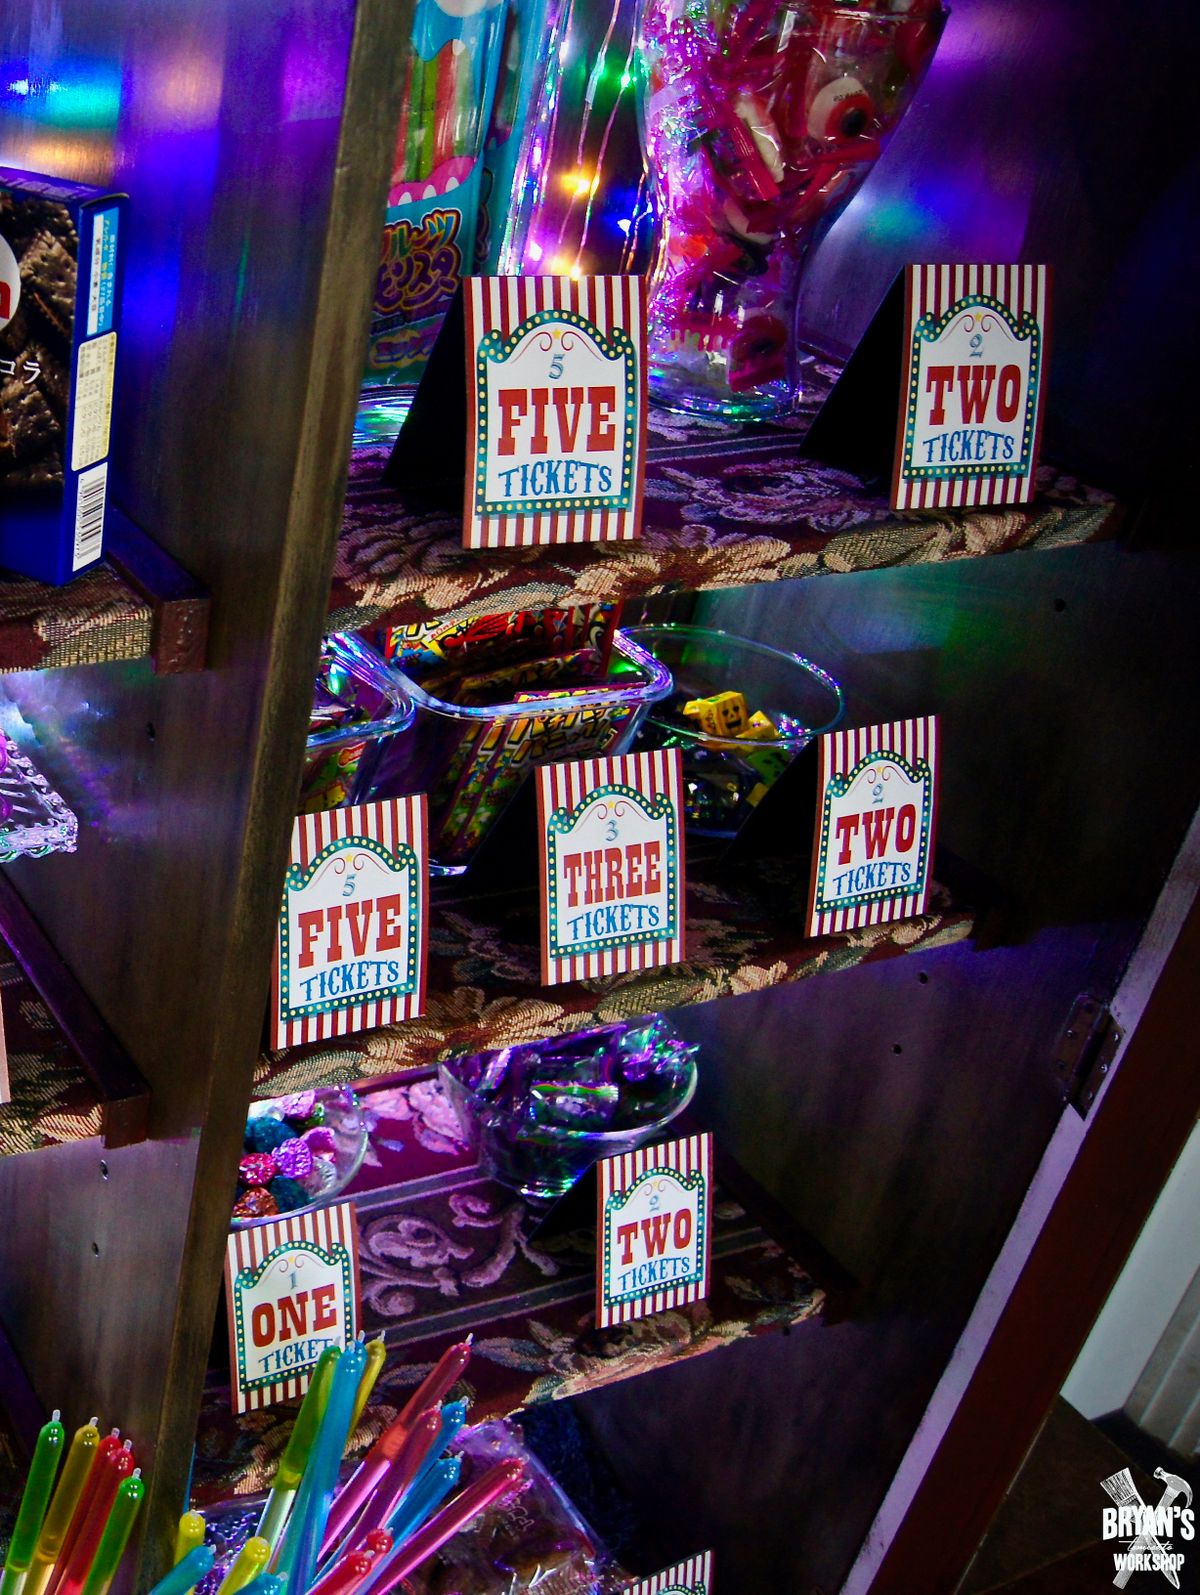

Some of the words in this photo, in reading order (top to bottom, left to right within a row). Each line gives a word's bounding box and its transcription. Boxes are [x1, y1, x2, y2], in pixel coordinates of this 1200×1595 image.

[968, 334, 985, 358] 2
[548, 353, 566, 380] 5
[925, 364, 1021, 426] TWO
[497, 386, 616, 456] FIVE
[922, 429, 1014, 463] TICKETS
[498, 459, 612, 497] TICKETS
[871, 783, 884, 804] 2
[605, 819, 620, 842] 3
[835, 803, 916, 866] TWO
[342, 872, 357, 897] 5
[563, 840, 661, 908] THREE
[832, 861, 911, 896] TICKETS
[298, 893, 401, 969] FIVE
[566, 903, 660, 941] TICKETS
[299, 960, 399, 1001] TICKETS
[617, 1208, 692, 1266] TWO
[618, 1256, 690, 1291] TICKETS
[251, 1283, 337, 1348] ONE
